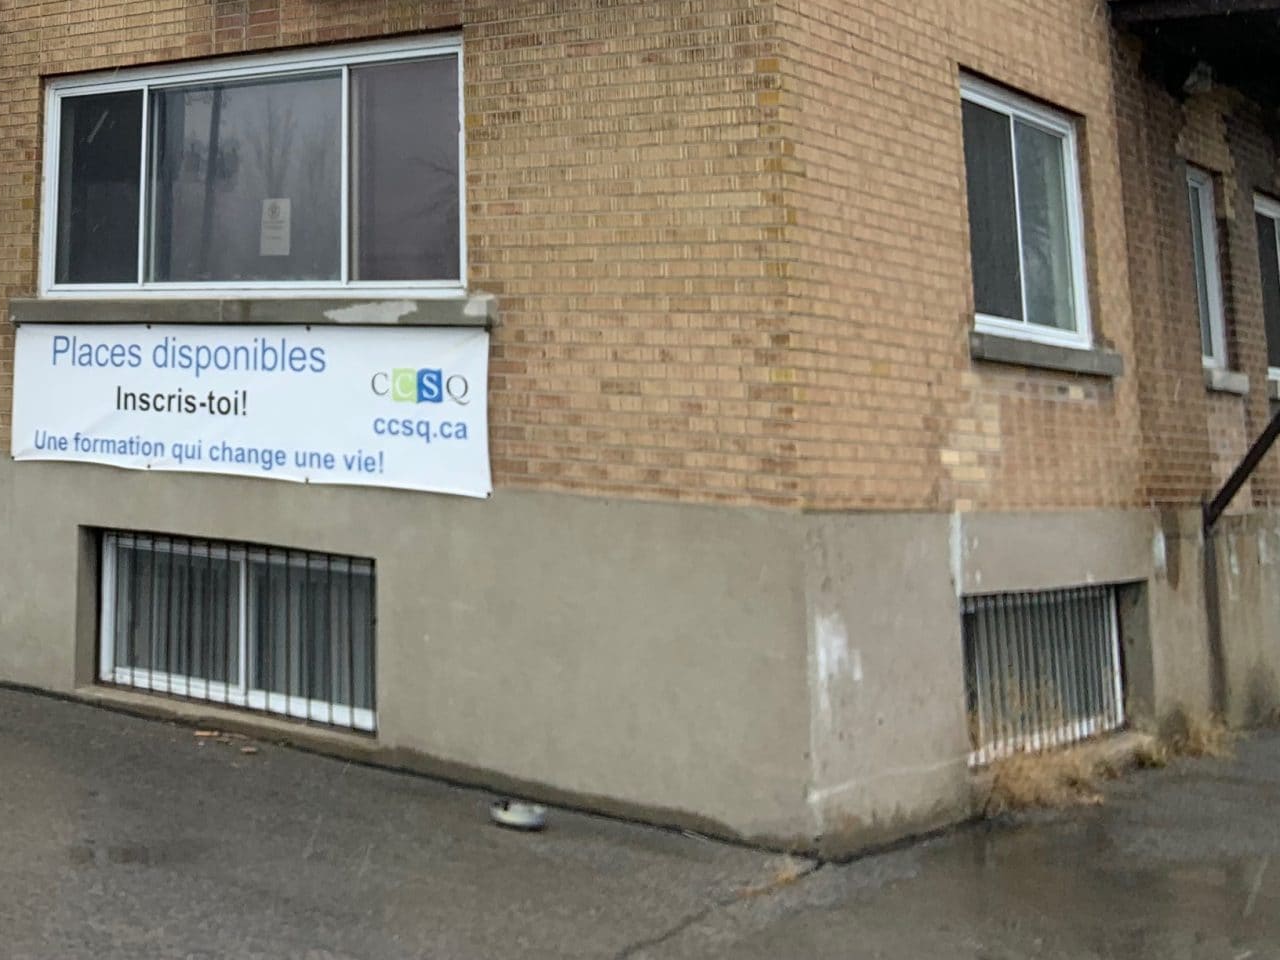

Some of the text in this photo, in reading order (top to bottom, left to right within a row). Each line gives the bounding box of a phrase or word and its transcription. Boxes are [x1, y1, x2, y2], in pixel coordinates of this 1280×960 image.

[51, 334, 327, 378] Places disponibles
[115, 385, 249, 417] Inscris-toi!
[370, 369, 472, 405] CCSQ
[372, 416, 469, 443] ccsq.ca
[33, 430, 385, 474] Une formation qui change une vie!
